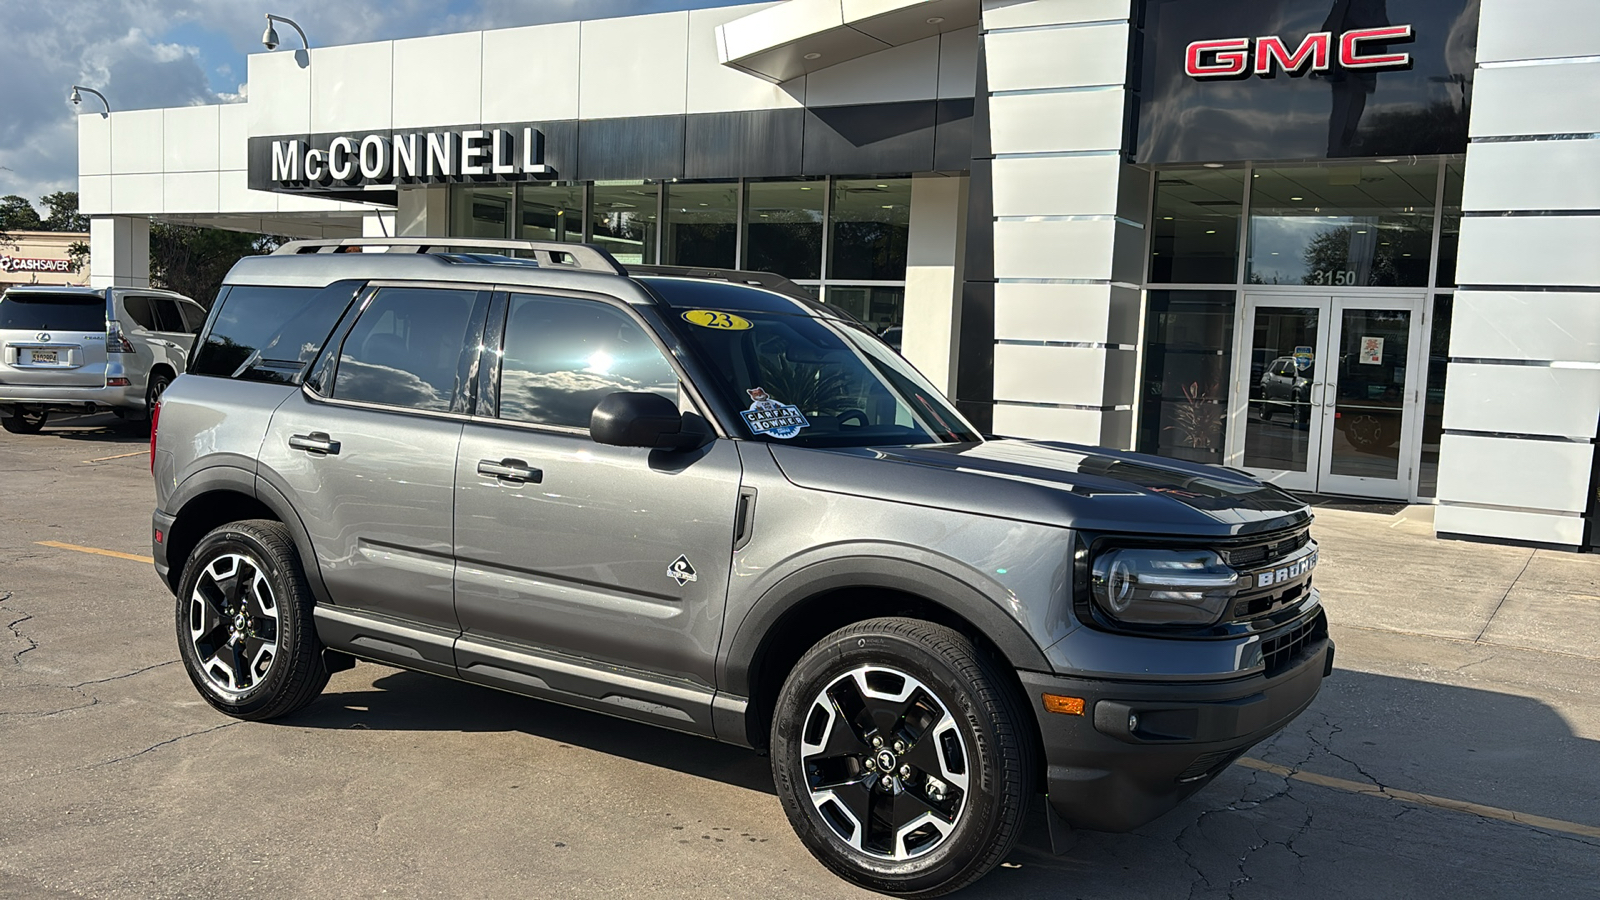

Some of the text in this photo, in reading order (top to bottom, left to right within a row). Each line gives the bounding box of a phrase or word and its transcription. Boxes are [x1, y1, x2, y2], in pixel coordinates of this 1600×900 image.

[1185, 24, 1412, 77] GMC
[271, 127, 546, 182] McCONNELL
[13, 259, 69, 272] CASHSAVER
[1313, 270, 1356, 286] 3150
[704, 312, 734, 329] 23
[747, 408, 800, 421] CARFAX
[762, 417, 803, 429] OWNER
[1258, 552, 1319, 588] BRONC
